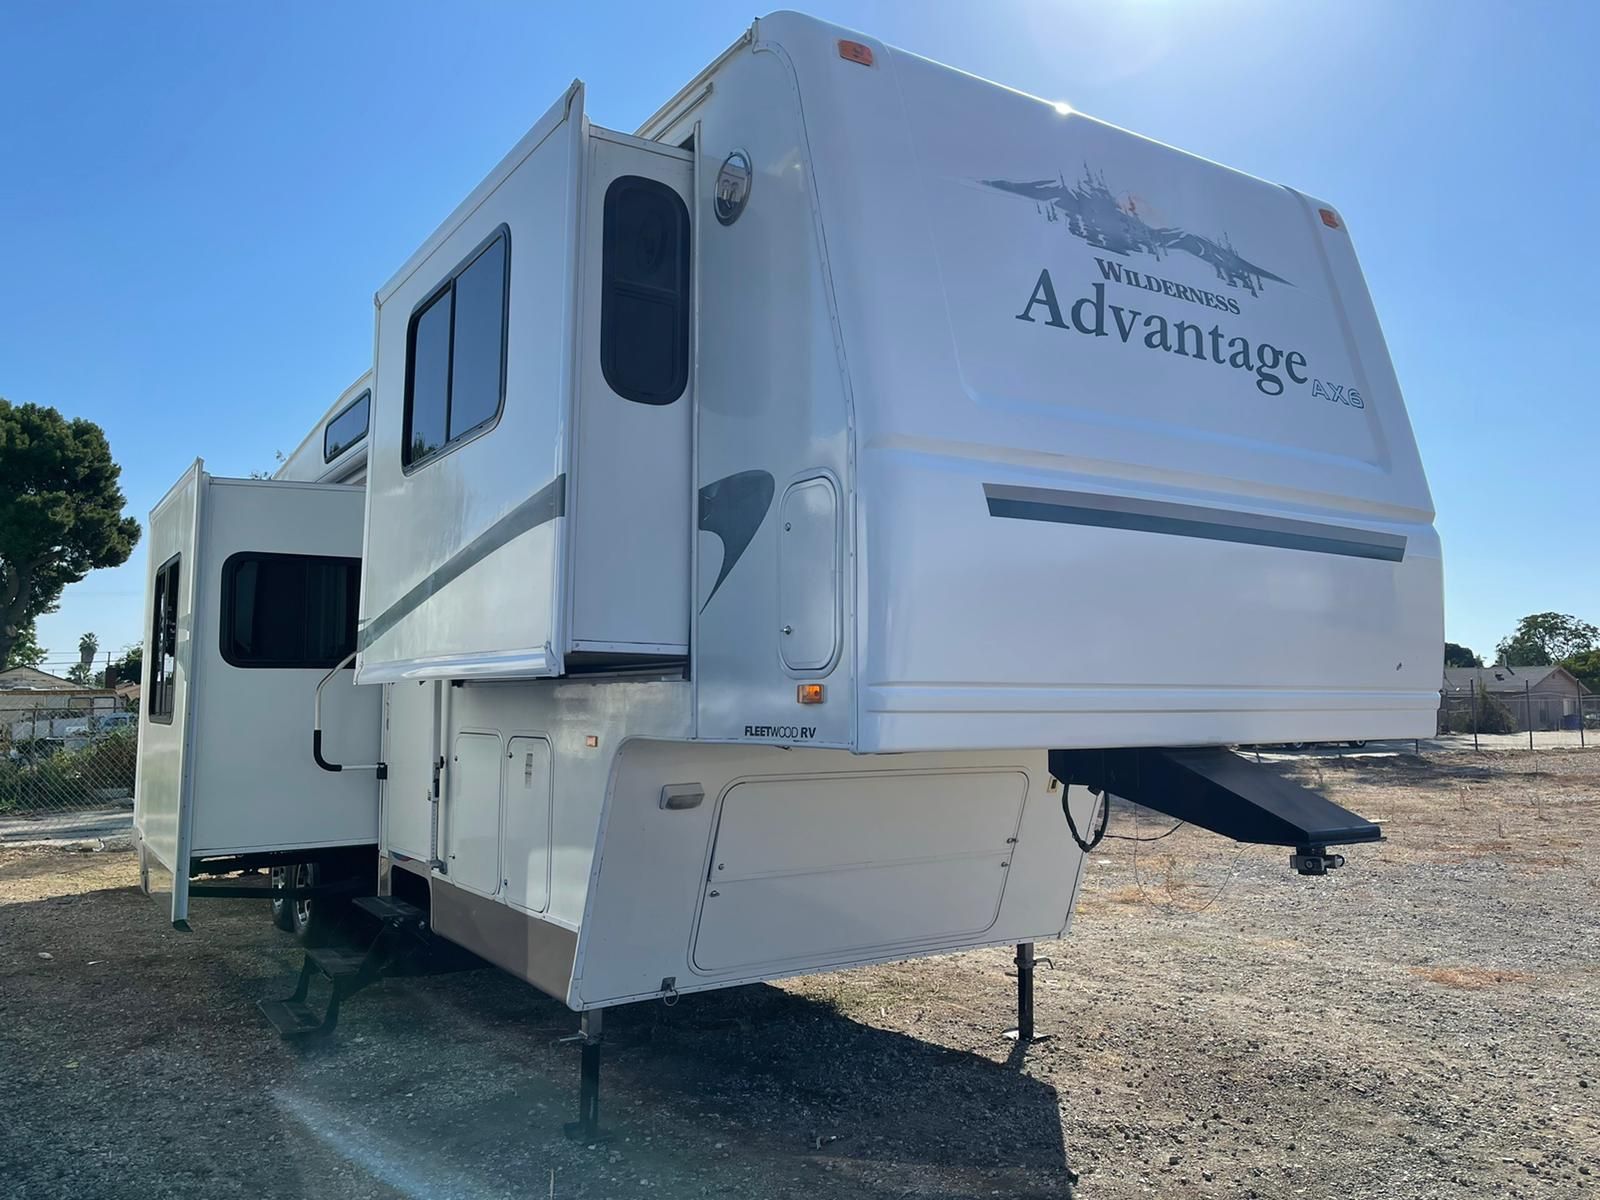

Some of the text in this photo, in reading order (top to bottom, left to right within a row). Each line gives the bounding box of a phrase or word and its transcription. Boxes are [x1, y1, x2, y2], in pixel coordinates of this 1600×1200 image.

[1094, 257, 1241, 315] WILDERNESS
[1015, 268, 1309, 396] Advantage
[744, 725, 817, 739] FLEETWOOD RV
